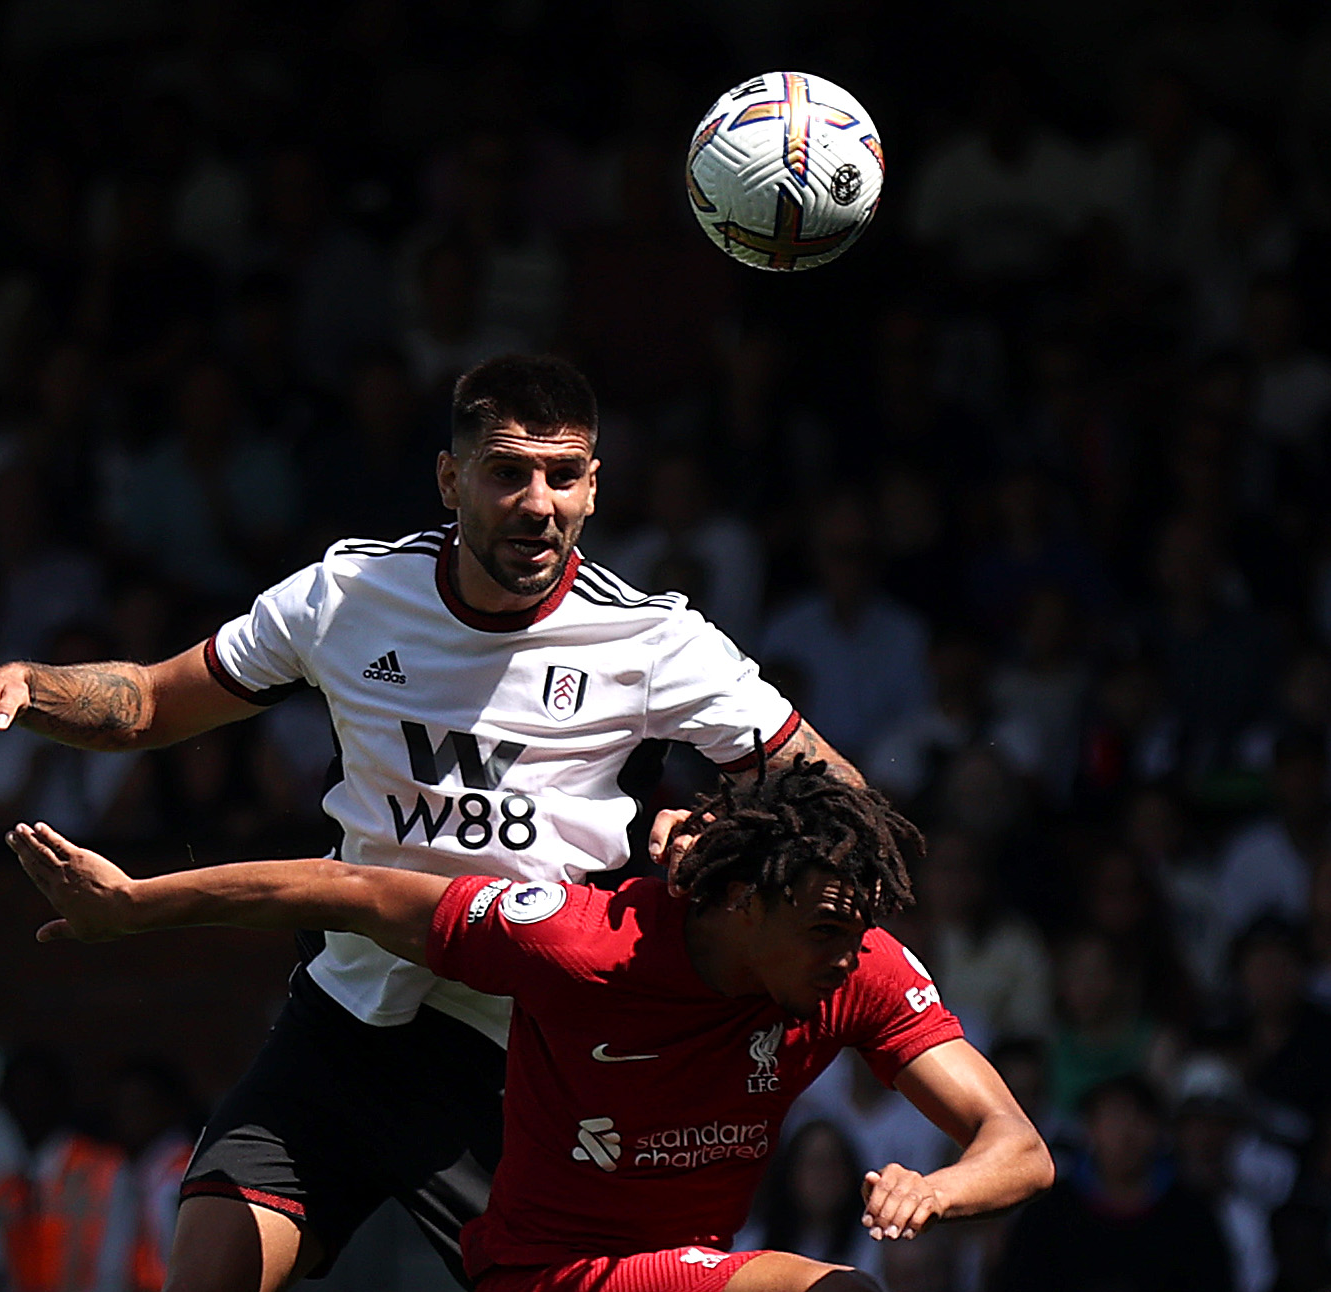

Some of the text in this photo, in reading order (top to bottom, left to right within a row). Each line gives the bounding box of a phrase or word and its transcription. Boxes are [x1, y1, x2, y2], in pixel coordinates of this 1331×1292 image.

[363, 669, 407, 684] adidas
[386, 792, 537, 851] W88
[635, 1120, 767, 1149] standard
[634, 1135, 768, 1168] chartered
